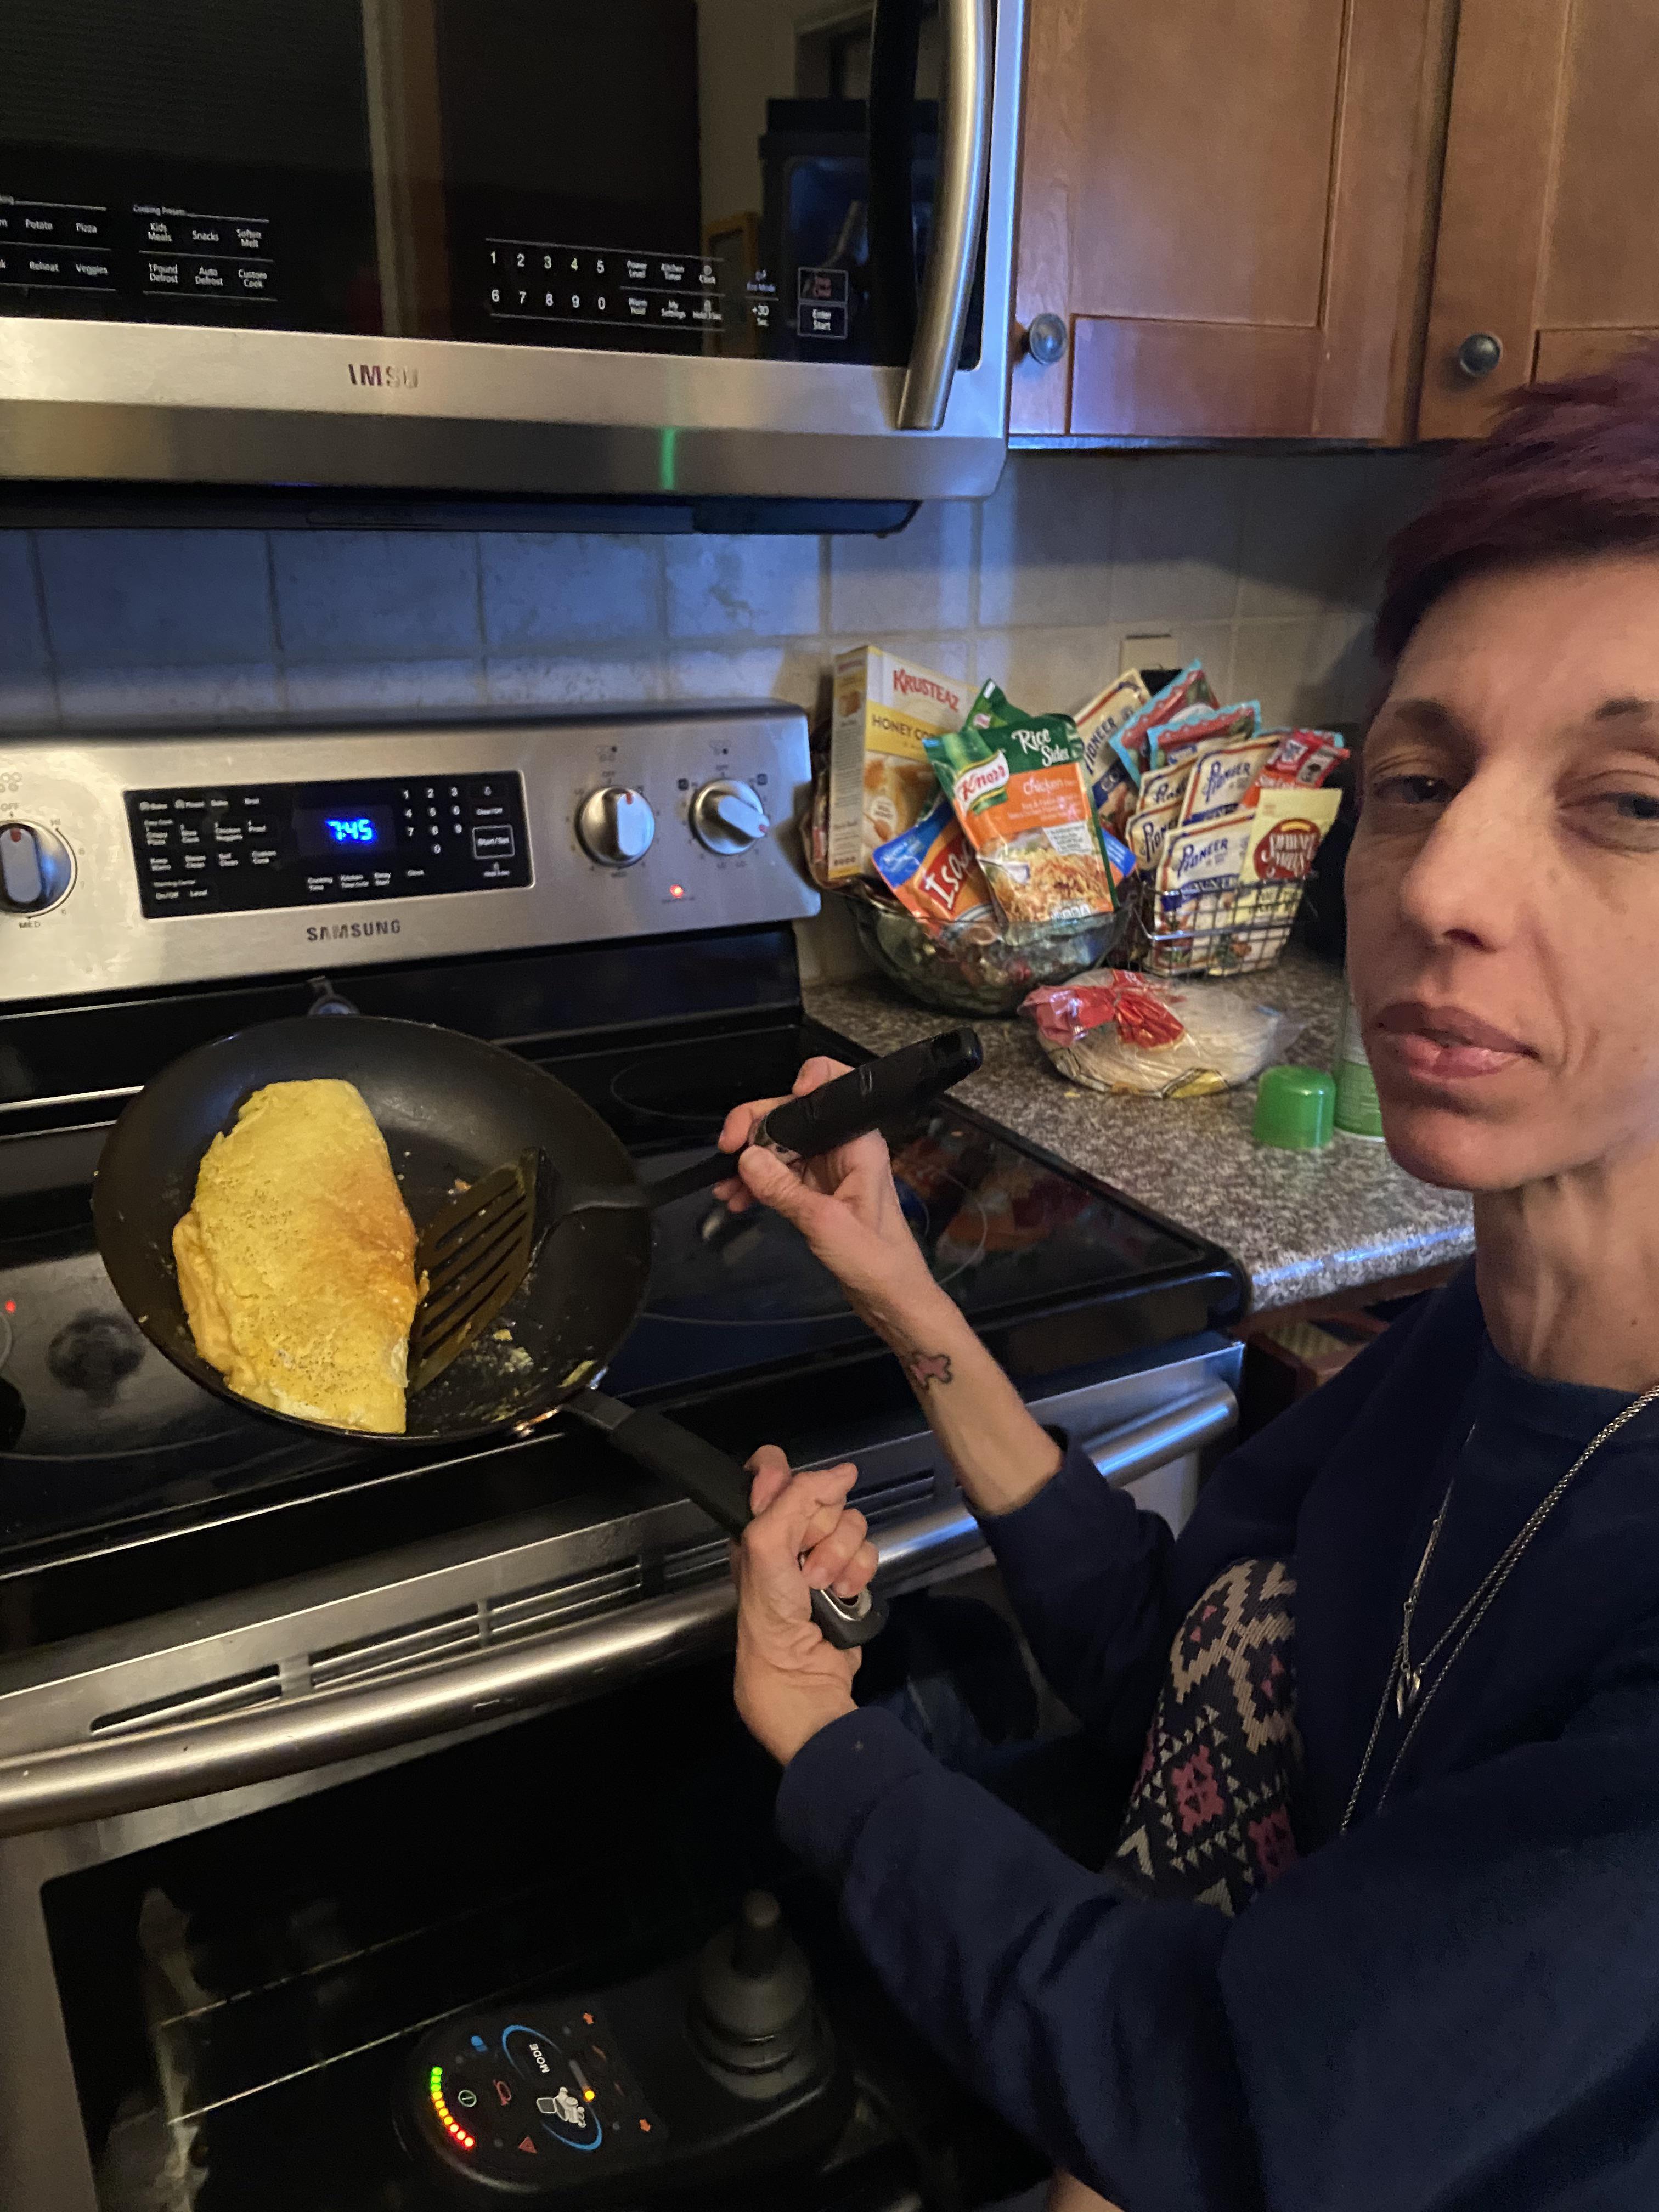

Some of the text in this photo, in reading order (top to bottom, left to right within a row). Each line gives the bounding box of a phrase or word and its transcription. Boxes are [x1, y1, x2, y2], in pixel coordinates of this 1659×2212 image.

[26, 219, 53, 230] Potato
[76, 223, 97, 233] Pizza
[150, 222, 167, 232] Kids
[193, 230, 219, 241] Snacks
[30, 261, 60, 272] Reheat
[490, 250, 605, 273] 1 2 3 4 5
[76, 263, 108, 276] Veggies
[199, 266, 218, 276] Auto
[244, 278, 263, 288] Cook
[492, 289, 606, 311] 6 7 8 9 0
[893, 668, 959, 712] KRUSTEAZ
[872, 714, 911, 737] HONEY
[1011, 729, 1051, 754] Rice
[1041, 744, 1070, 767] Sides
[961, 765, 1006, 801] Knorr
[403, 787, 458, 799] 1 2 3
[405, 809, 412, 818] 4
[328, 818, 373, 842] 7:45
[407, 826, 414, 837] 7
[434, 843, 441, 854] 0
[1177, 838, 1228, 879] PIONEER
[306, 918, 401, 941] SAMSUNG
[529, 2043, 550, 2073] MODE
